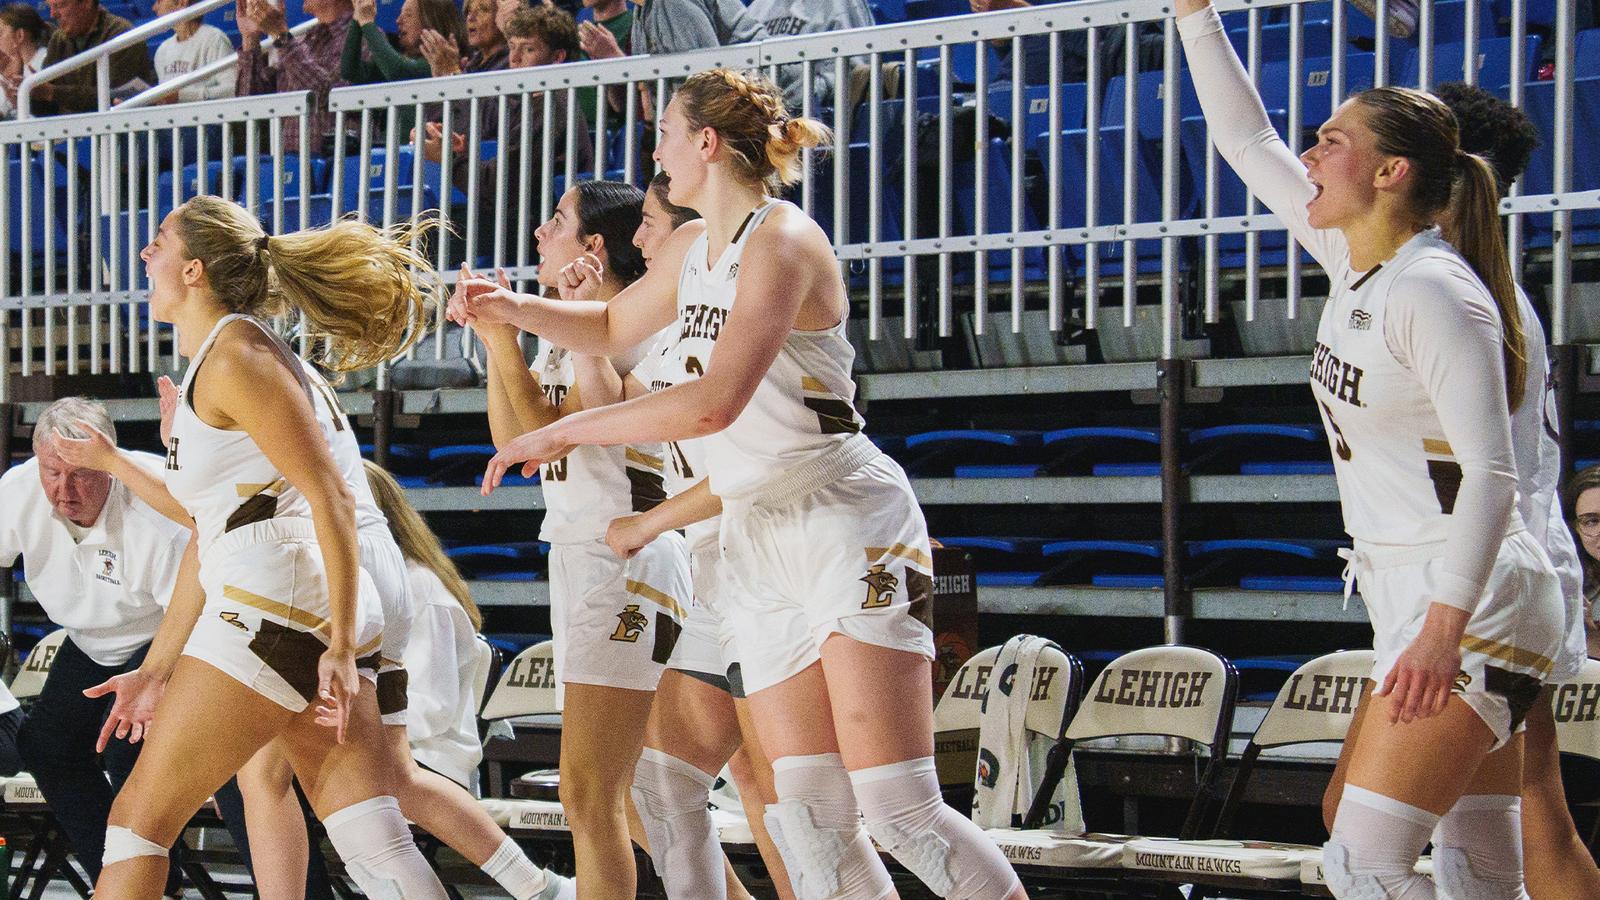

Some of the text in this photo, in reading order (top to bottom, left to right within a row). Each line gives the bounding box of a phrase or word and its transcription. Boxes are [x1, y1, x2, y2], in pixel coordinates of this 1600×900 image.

[764, 16, 807, 36] HIGH
[1310, 342, 1364, 408] HIGH
[1094, 668, 1213, 709] LEHIGH
[520, 810, 563, 827] MOUNTAIN
[1135, 852, 1242, 874] MOUNTAIN HAWKS
